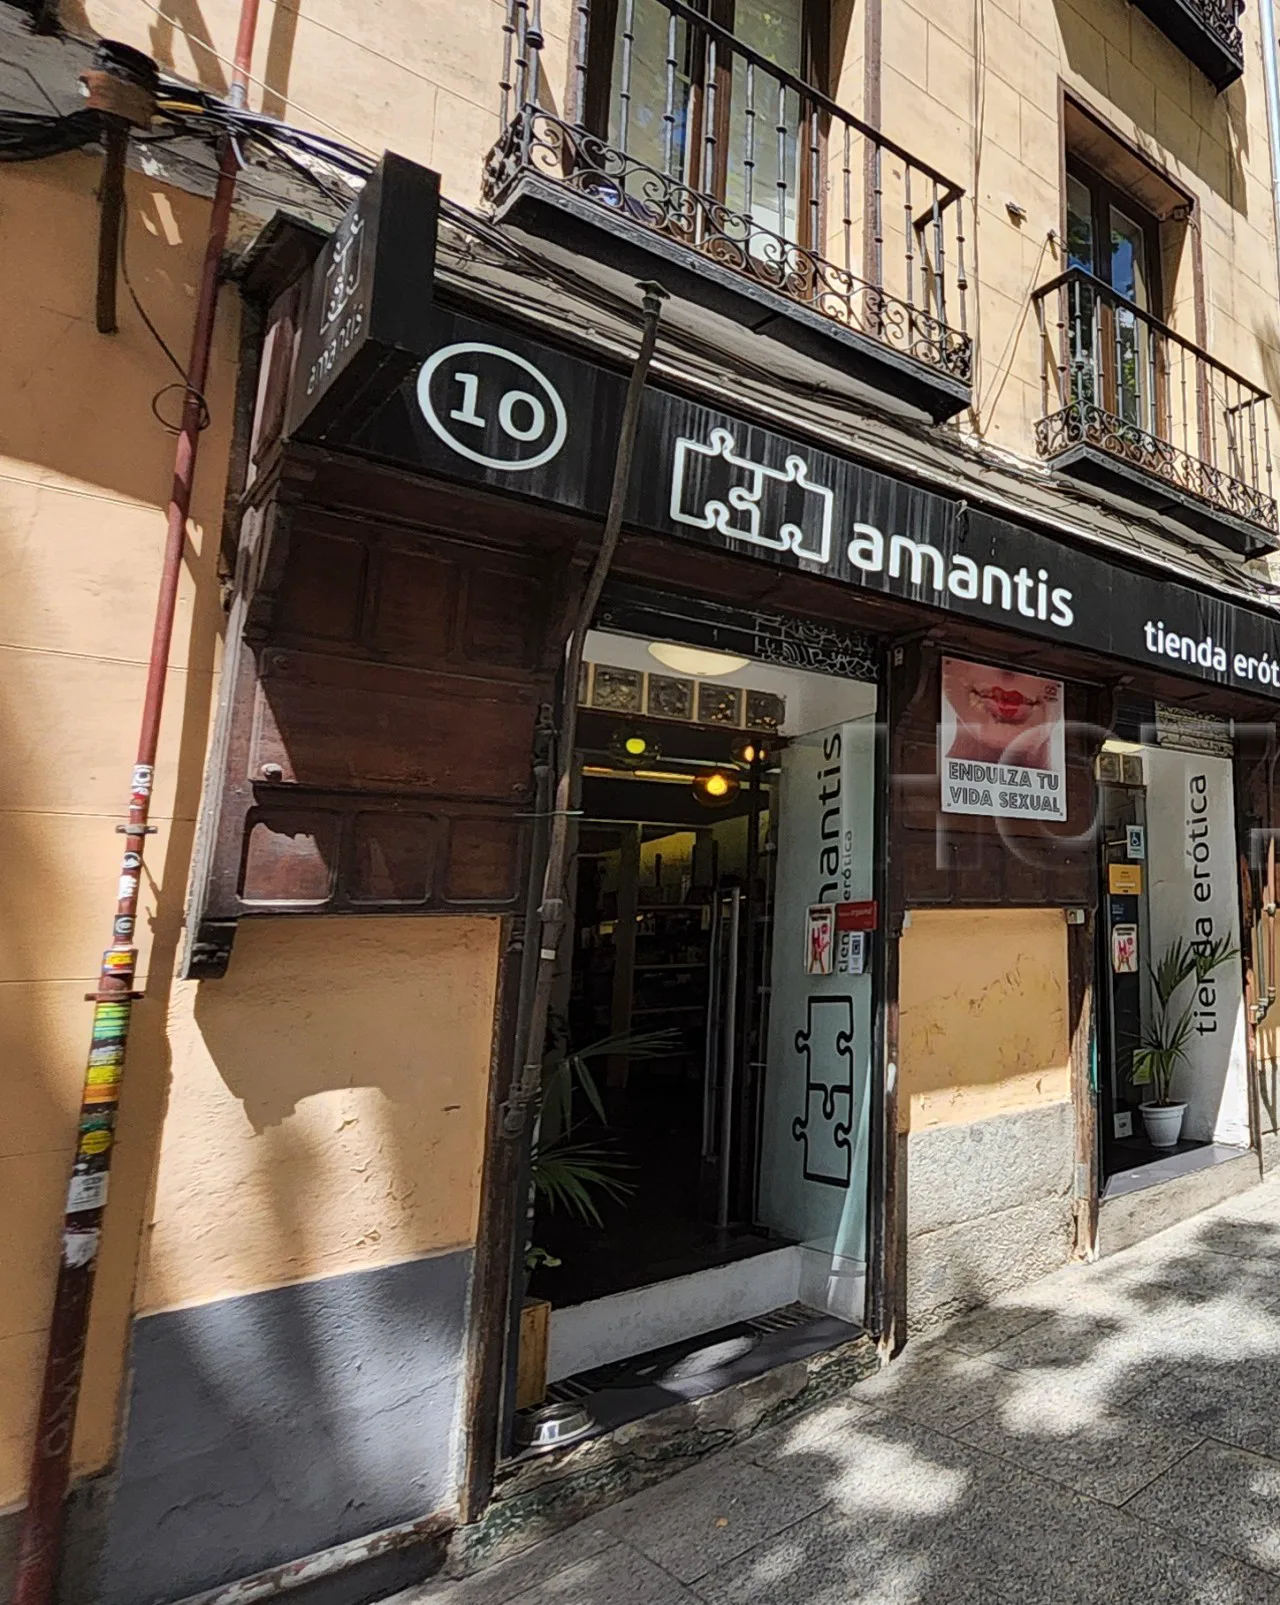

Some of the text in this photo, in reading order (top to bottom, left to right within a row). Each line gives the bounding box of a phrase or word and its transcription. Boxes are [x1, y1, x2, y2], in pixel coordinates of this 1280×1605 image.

[448, 372, 546, 443] 10
[847, 521, 1075, 628] amantis
[1144, 619, 1228, 674] tienda
[948, 761, 1060, 791] ENDULZA TU
[950, 786, 1061, 813] VIDA SEXUAL
[840, 829, 854, 902] erótica
[1185, 773, 1212, 903] erótica
